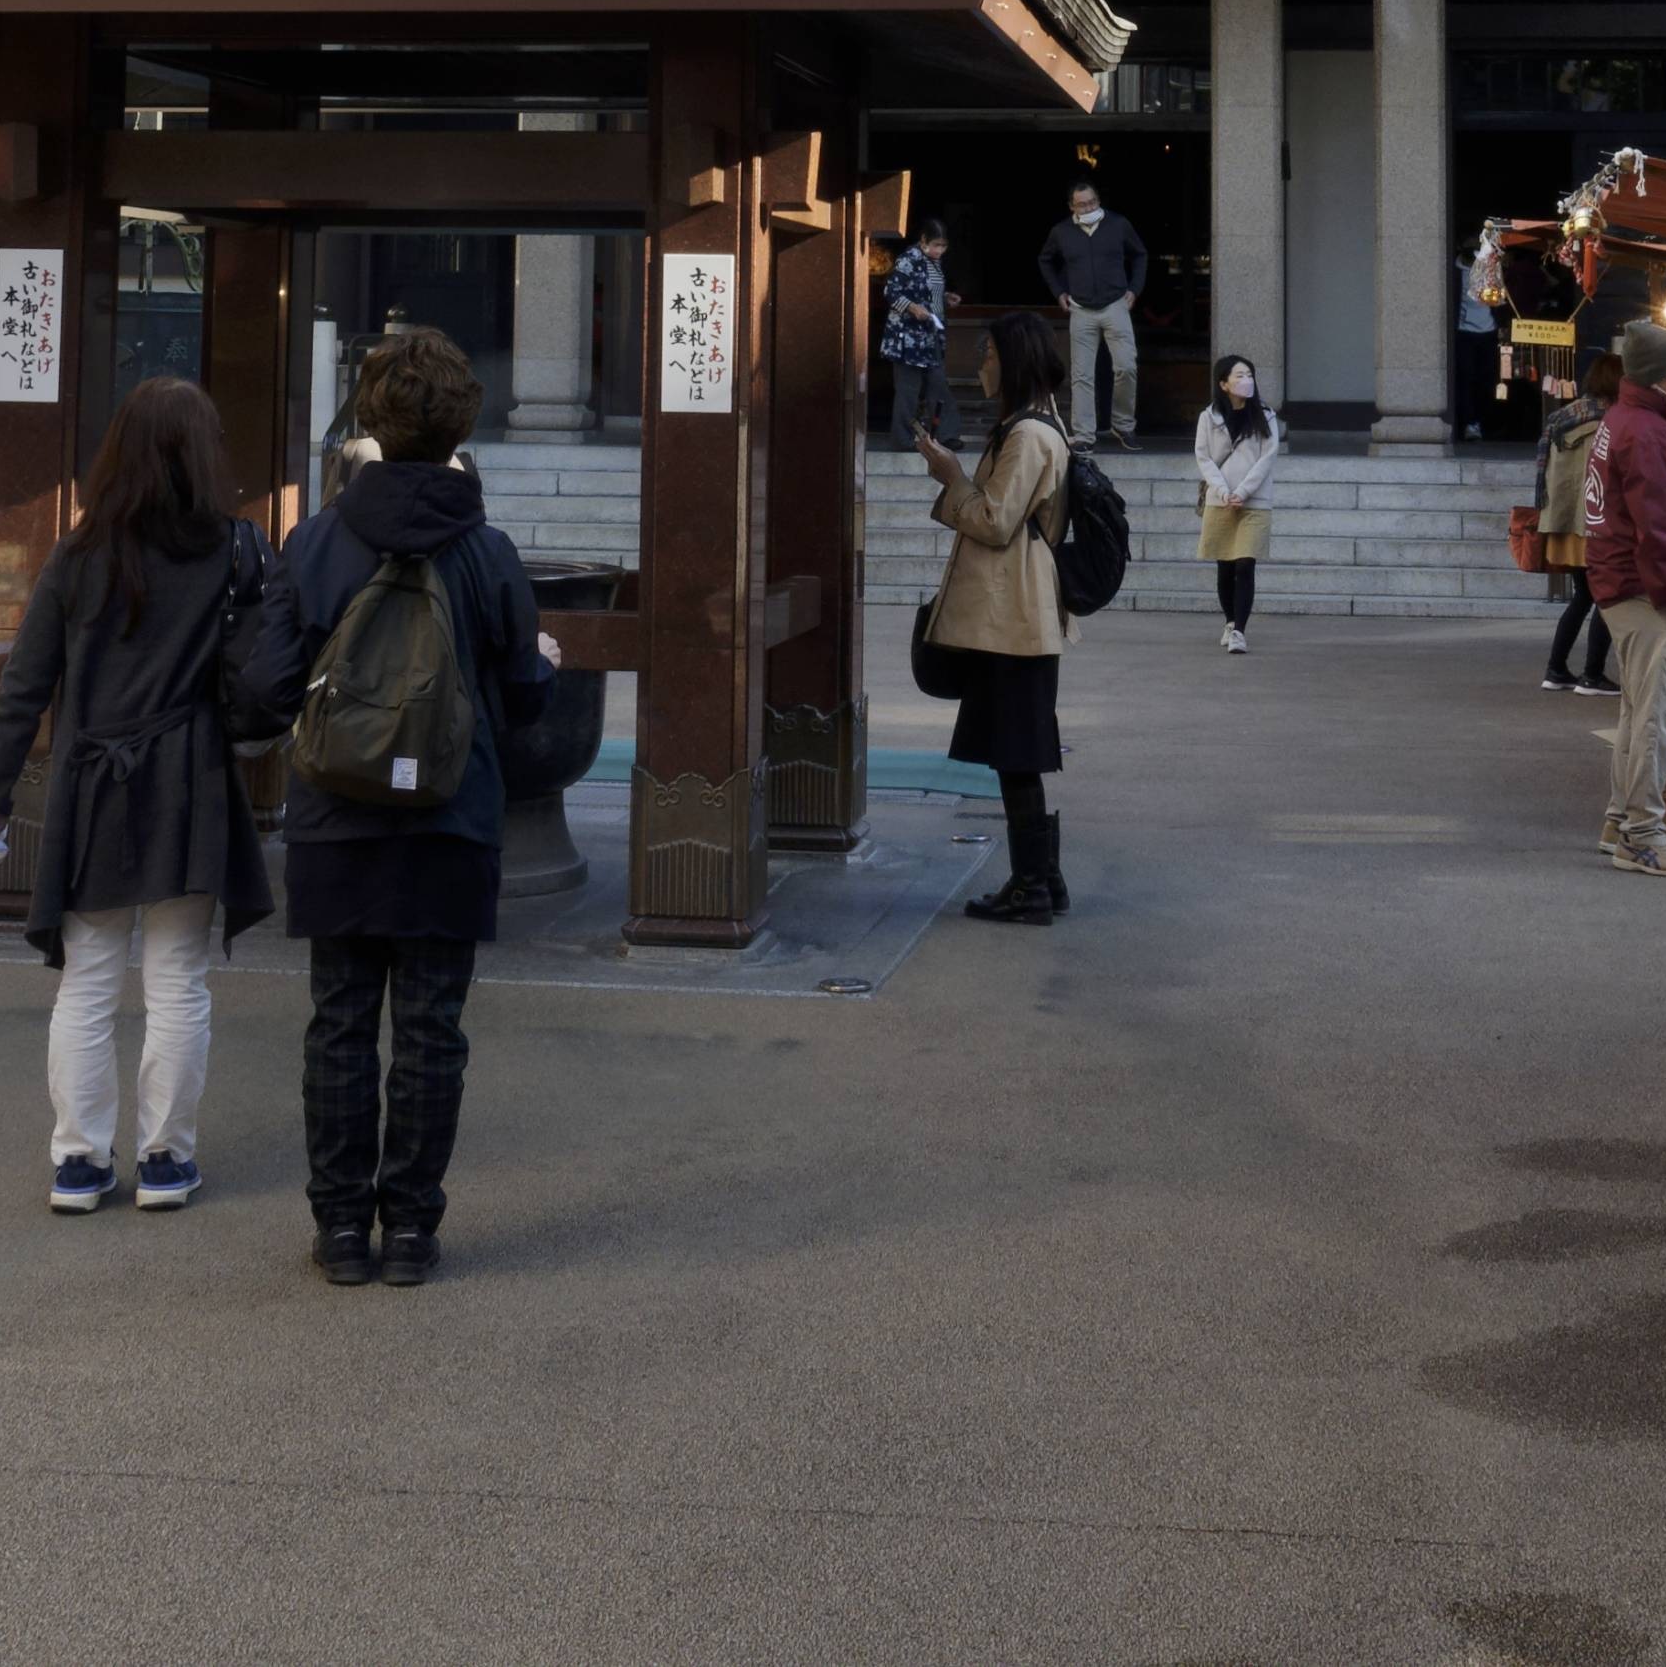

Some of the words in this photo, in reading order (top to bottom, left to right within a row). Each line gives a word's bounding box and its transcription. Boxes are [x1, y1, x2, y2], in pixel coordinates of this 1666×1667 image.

[0, 285, 20, 363] 本堂へ
[19, 260, 39, 391] 古い御札などは
[37, 269, 56, 375] おたきあげ
[668, 292, 688, 372] 本堂へ
[688, 266, 707, 401] 古い御札などは
[708, 274, 726, 384] おたきあげ
